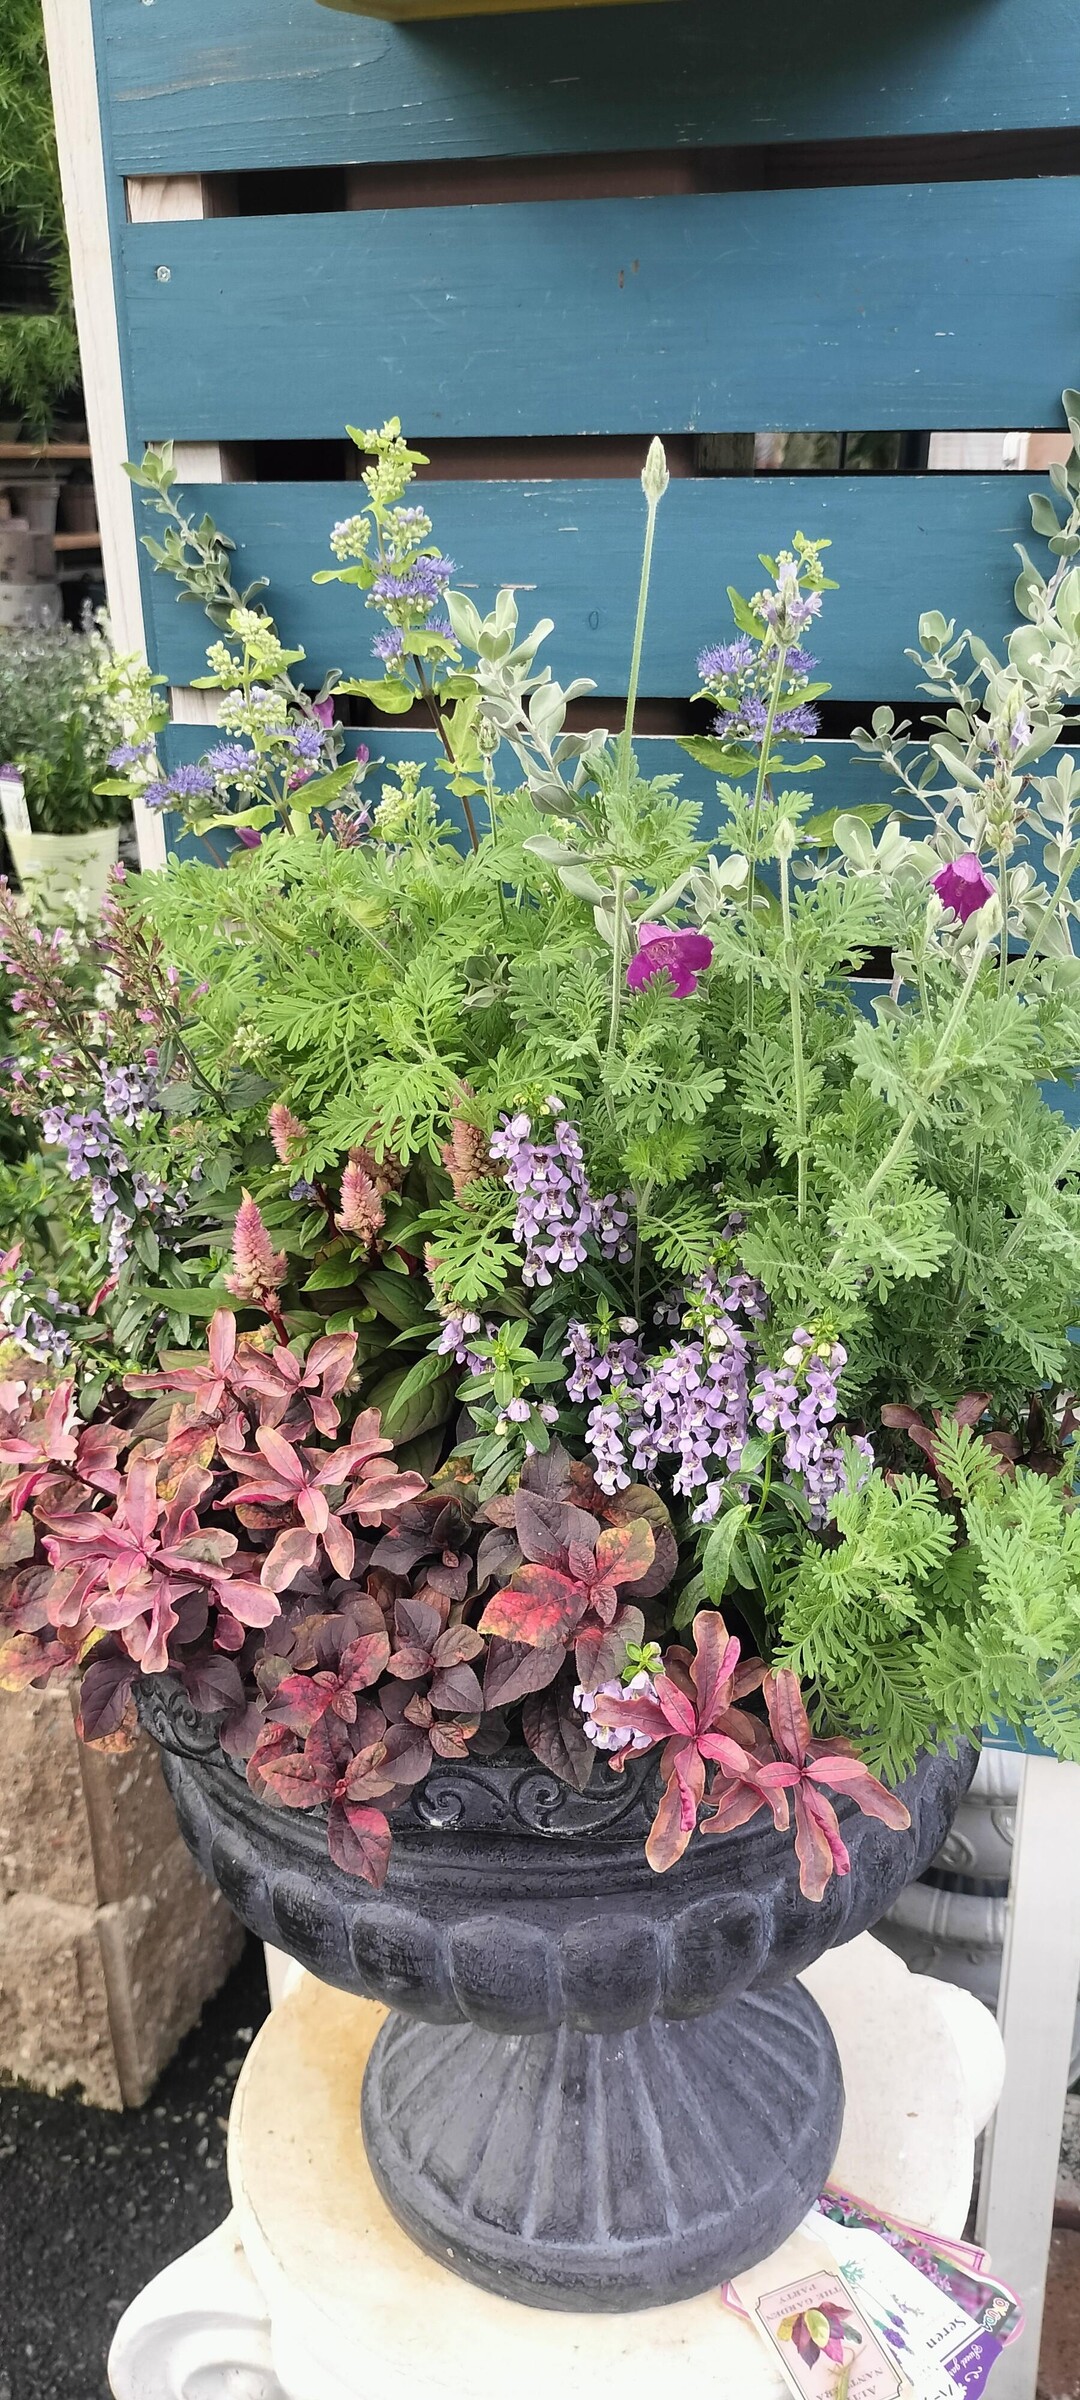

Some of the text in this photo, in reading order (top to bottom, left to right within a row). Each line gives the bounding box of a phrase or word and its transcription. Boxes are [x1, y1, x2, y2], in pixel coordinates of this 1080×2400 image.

[765, 2286, 842, 2321] THE GARDEN
[779, 2283, 817, 2304] PARTY
[926, 2318, 967, 2349] Seren
